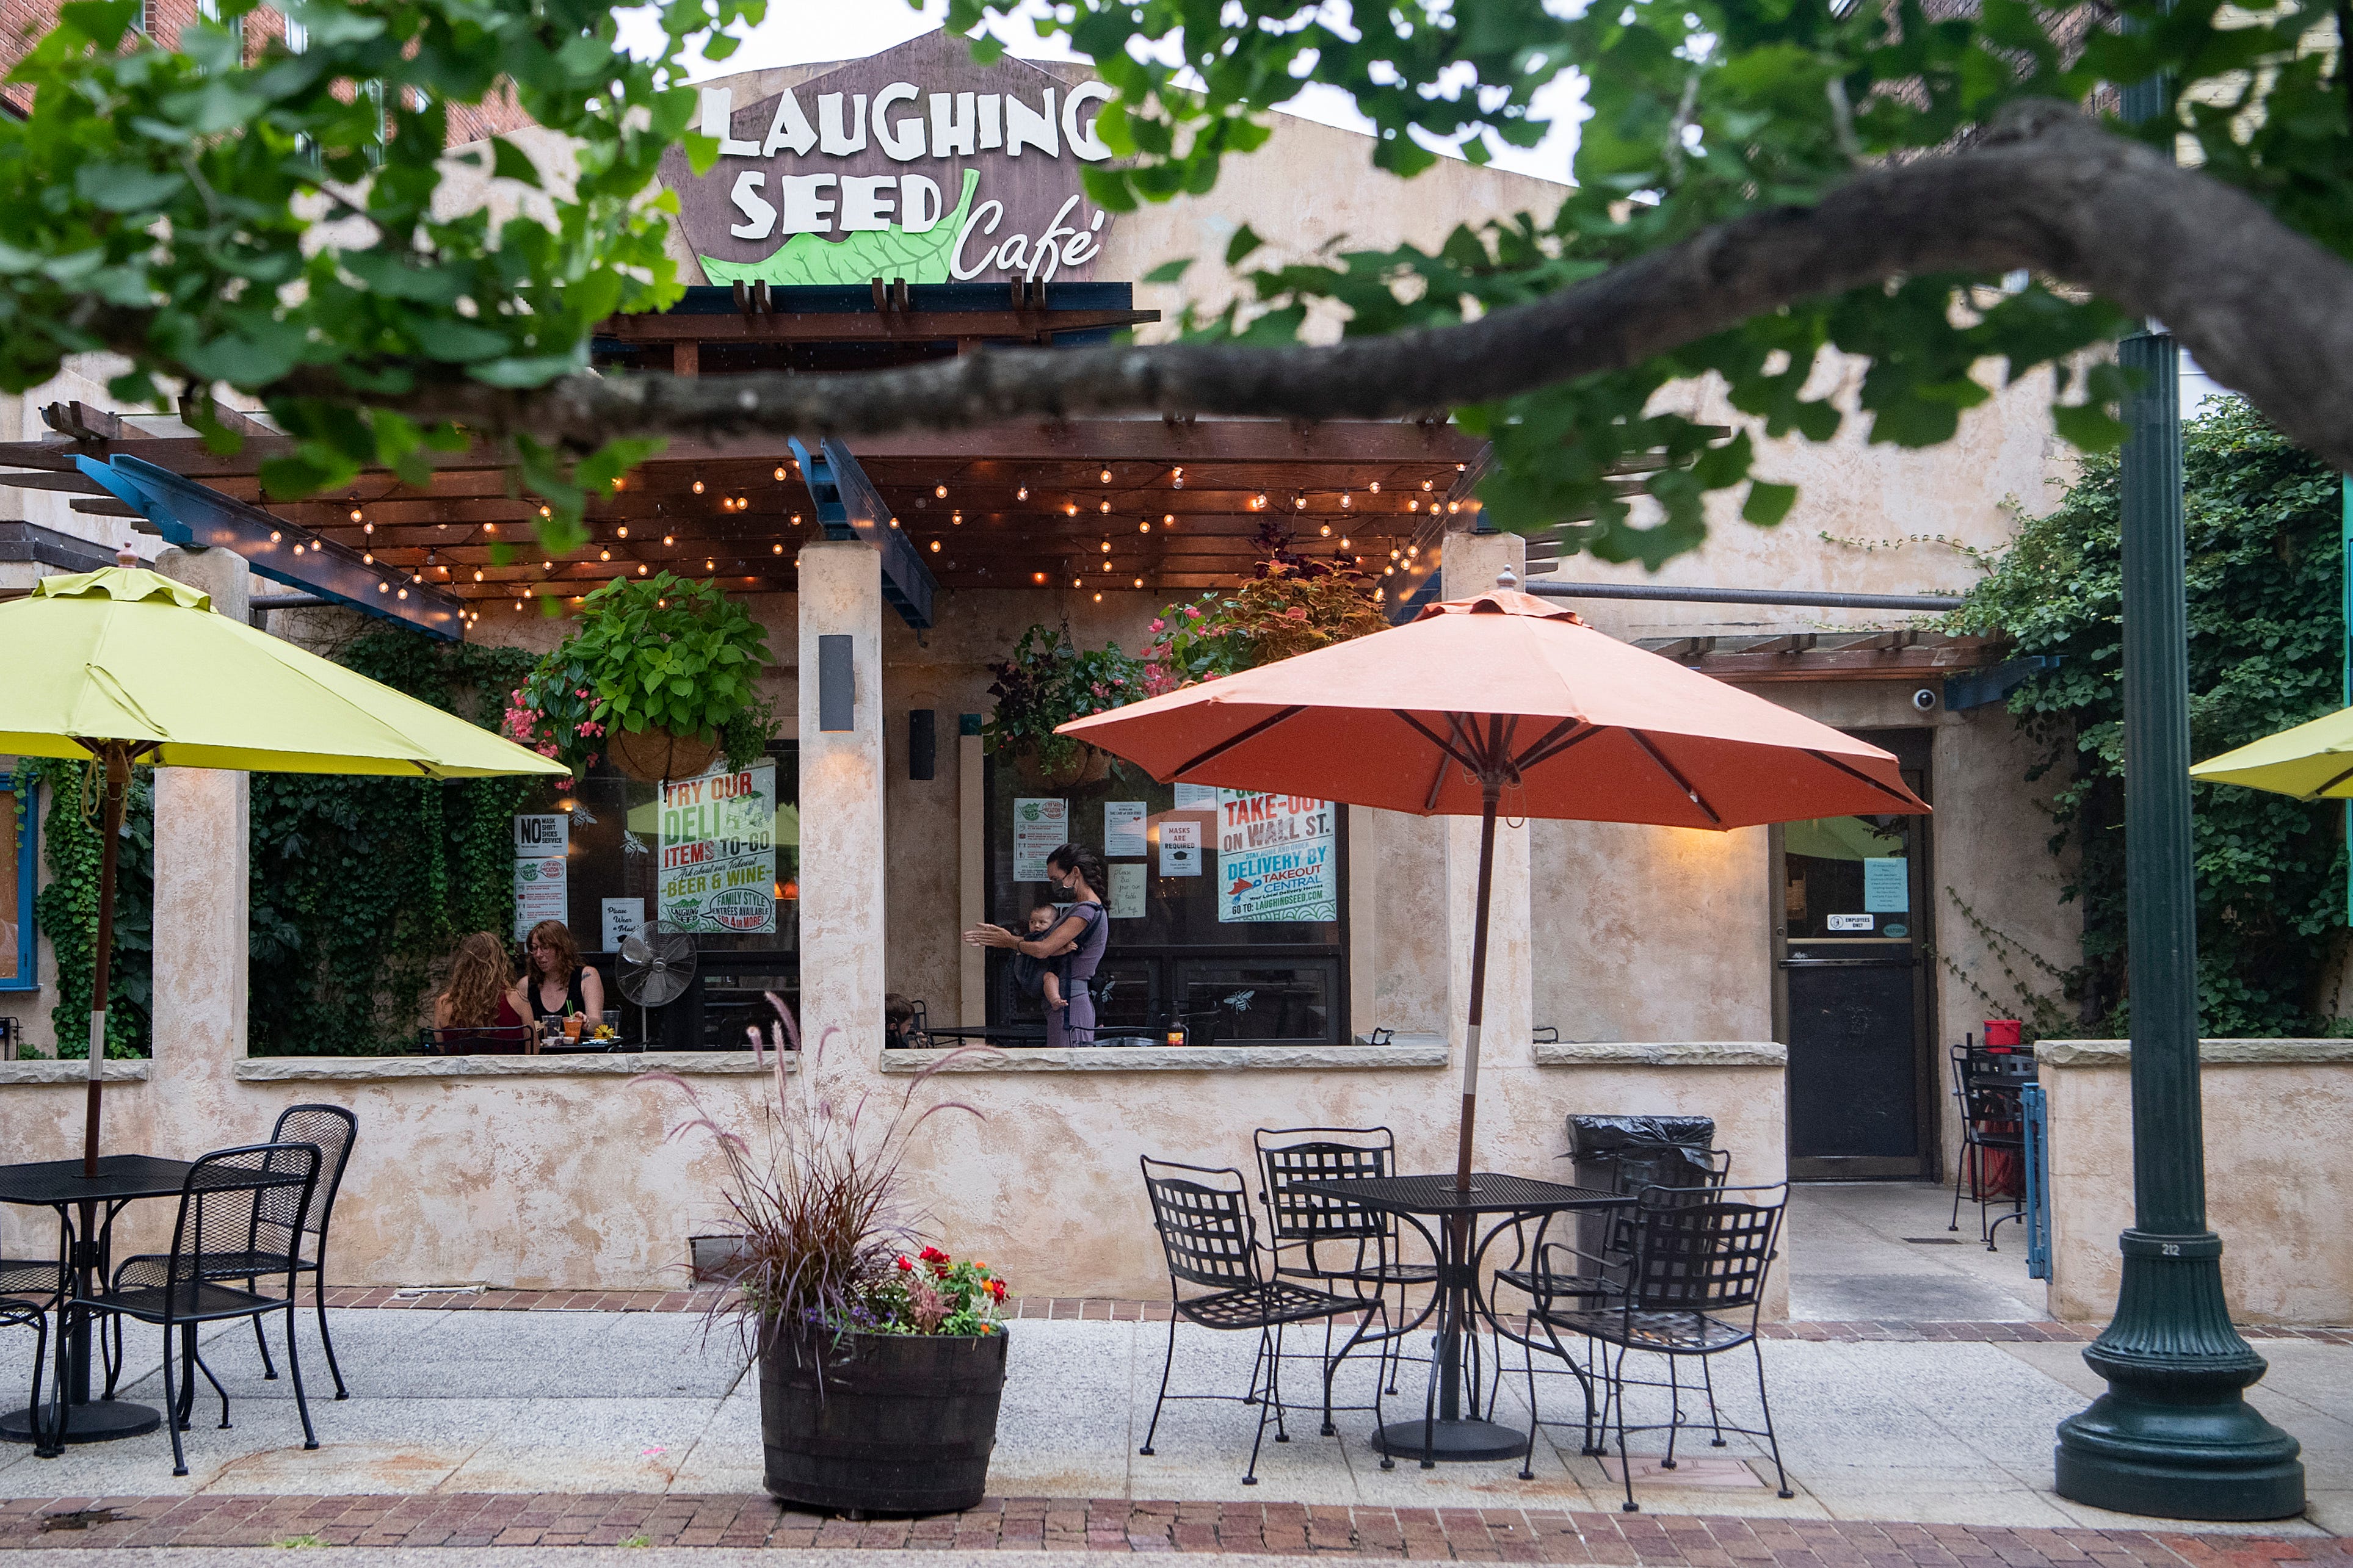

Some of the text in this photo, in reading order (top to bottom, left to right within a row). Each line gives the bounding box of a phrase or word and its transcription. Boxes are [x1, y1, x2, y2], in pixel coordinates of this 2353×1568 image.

[701, 81, 1113, 161] LAUGHING
[730, 170, 942, 239] SEED
[950, 194, 1106, 283] Café
[668, 772, 752, 808] TRY OUR
[521, 818, 541, 844] NO
[665, 802, 720, 846] DELI
[1224, 812, 1330, 852] ON WALL ST.
[665, 831, 769, 868] ITEMS TO-GO
[1246, 851, 1259, 859] STAY
[1278, 845, 1289, 854] AND
[1291, 842, 1309, 851] ORDER
[673, 856, 758, 881] Ask about our Takeout
[1228, 845, 1327, 881] DELIVERY BY
[1263, 864, 1322, 883] TAKEOUT
[711, 873, 722, 889] &
[1264, 875, 1322, 893] CENTRAL
[717, 891, 765, 907] FAMILY STYLE
[739, 907, 769, 916] AVAILABLE
[1232, 890, 1322, 914] GO TO: LAUGHINGSEED.COM
[718, 916, 728, 925] FOR
[731, 917, 736, 928] 4
[744, 916, 764, 928] MORE!
[2161, 1243, 2180, 1256] 212
